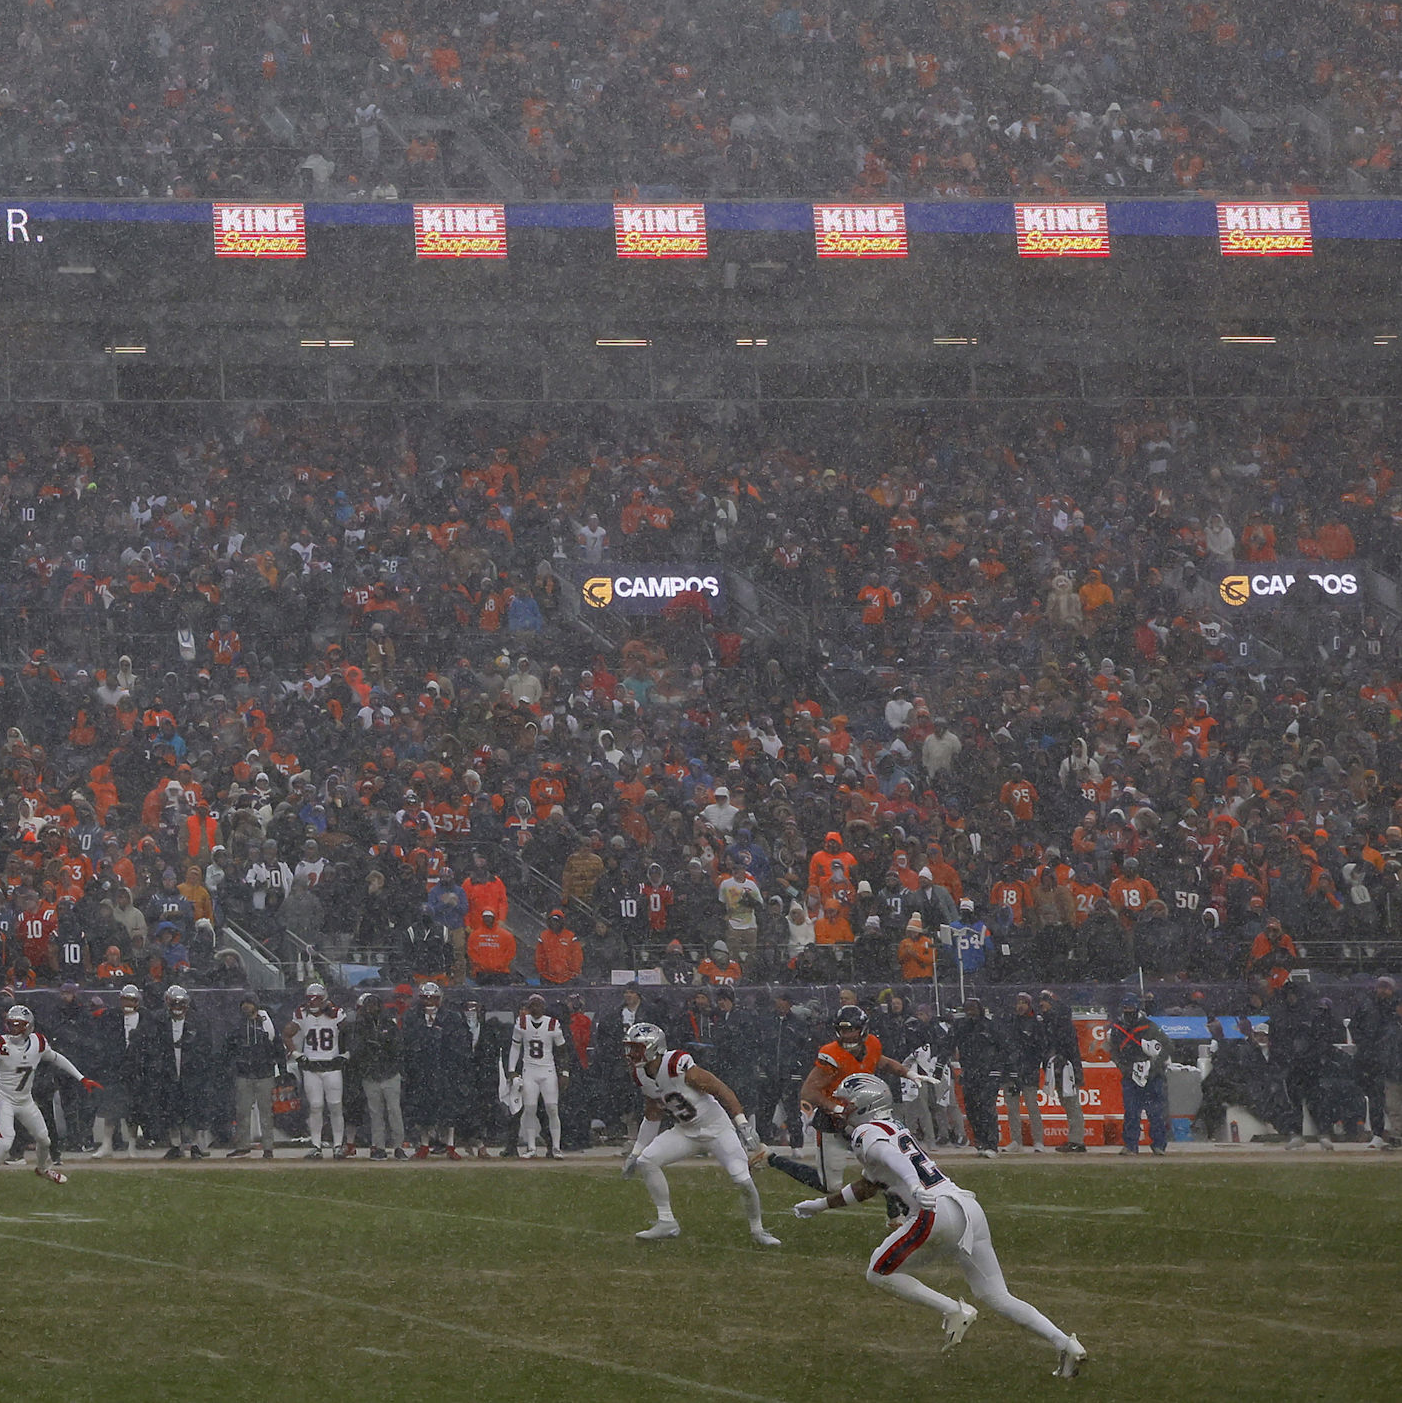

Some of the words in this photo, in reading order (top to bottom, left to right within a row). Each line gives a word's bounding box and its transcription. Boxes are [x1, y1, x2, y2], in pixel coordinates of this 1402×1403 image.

[221, 209, 297, 231] KING
[422, 209, 497, 231] KING
[623, 209, 697, 231] KING
[822, 210, 898, 231] KING
[1023, 208, 1098, 230] KING
[1225, 207, 1301, 229] KING
[22, 507, 35, 522] 10
[614, 577, 719, 598] CAMPOS
[1251, 574, 1358, 595] CAOS
[1012, 788, 1030, 804] 95
[1002, 889, 1017, 905] 18
[1122, 889, 1141, 908] 18
[1175, 891, 1200, 910] 50
[620, 899, 638, 918] 10
[26, 920, 43, 940] 10
[63, 943, 81, 964] 10
[306, 1028, 334, 1051] 48
[529, 1040, 544, 1059] 8
[14, 1067, 33, 1092] 7
